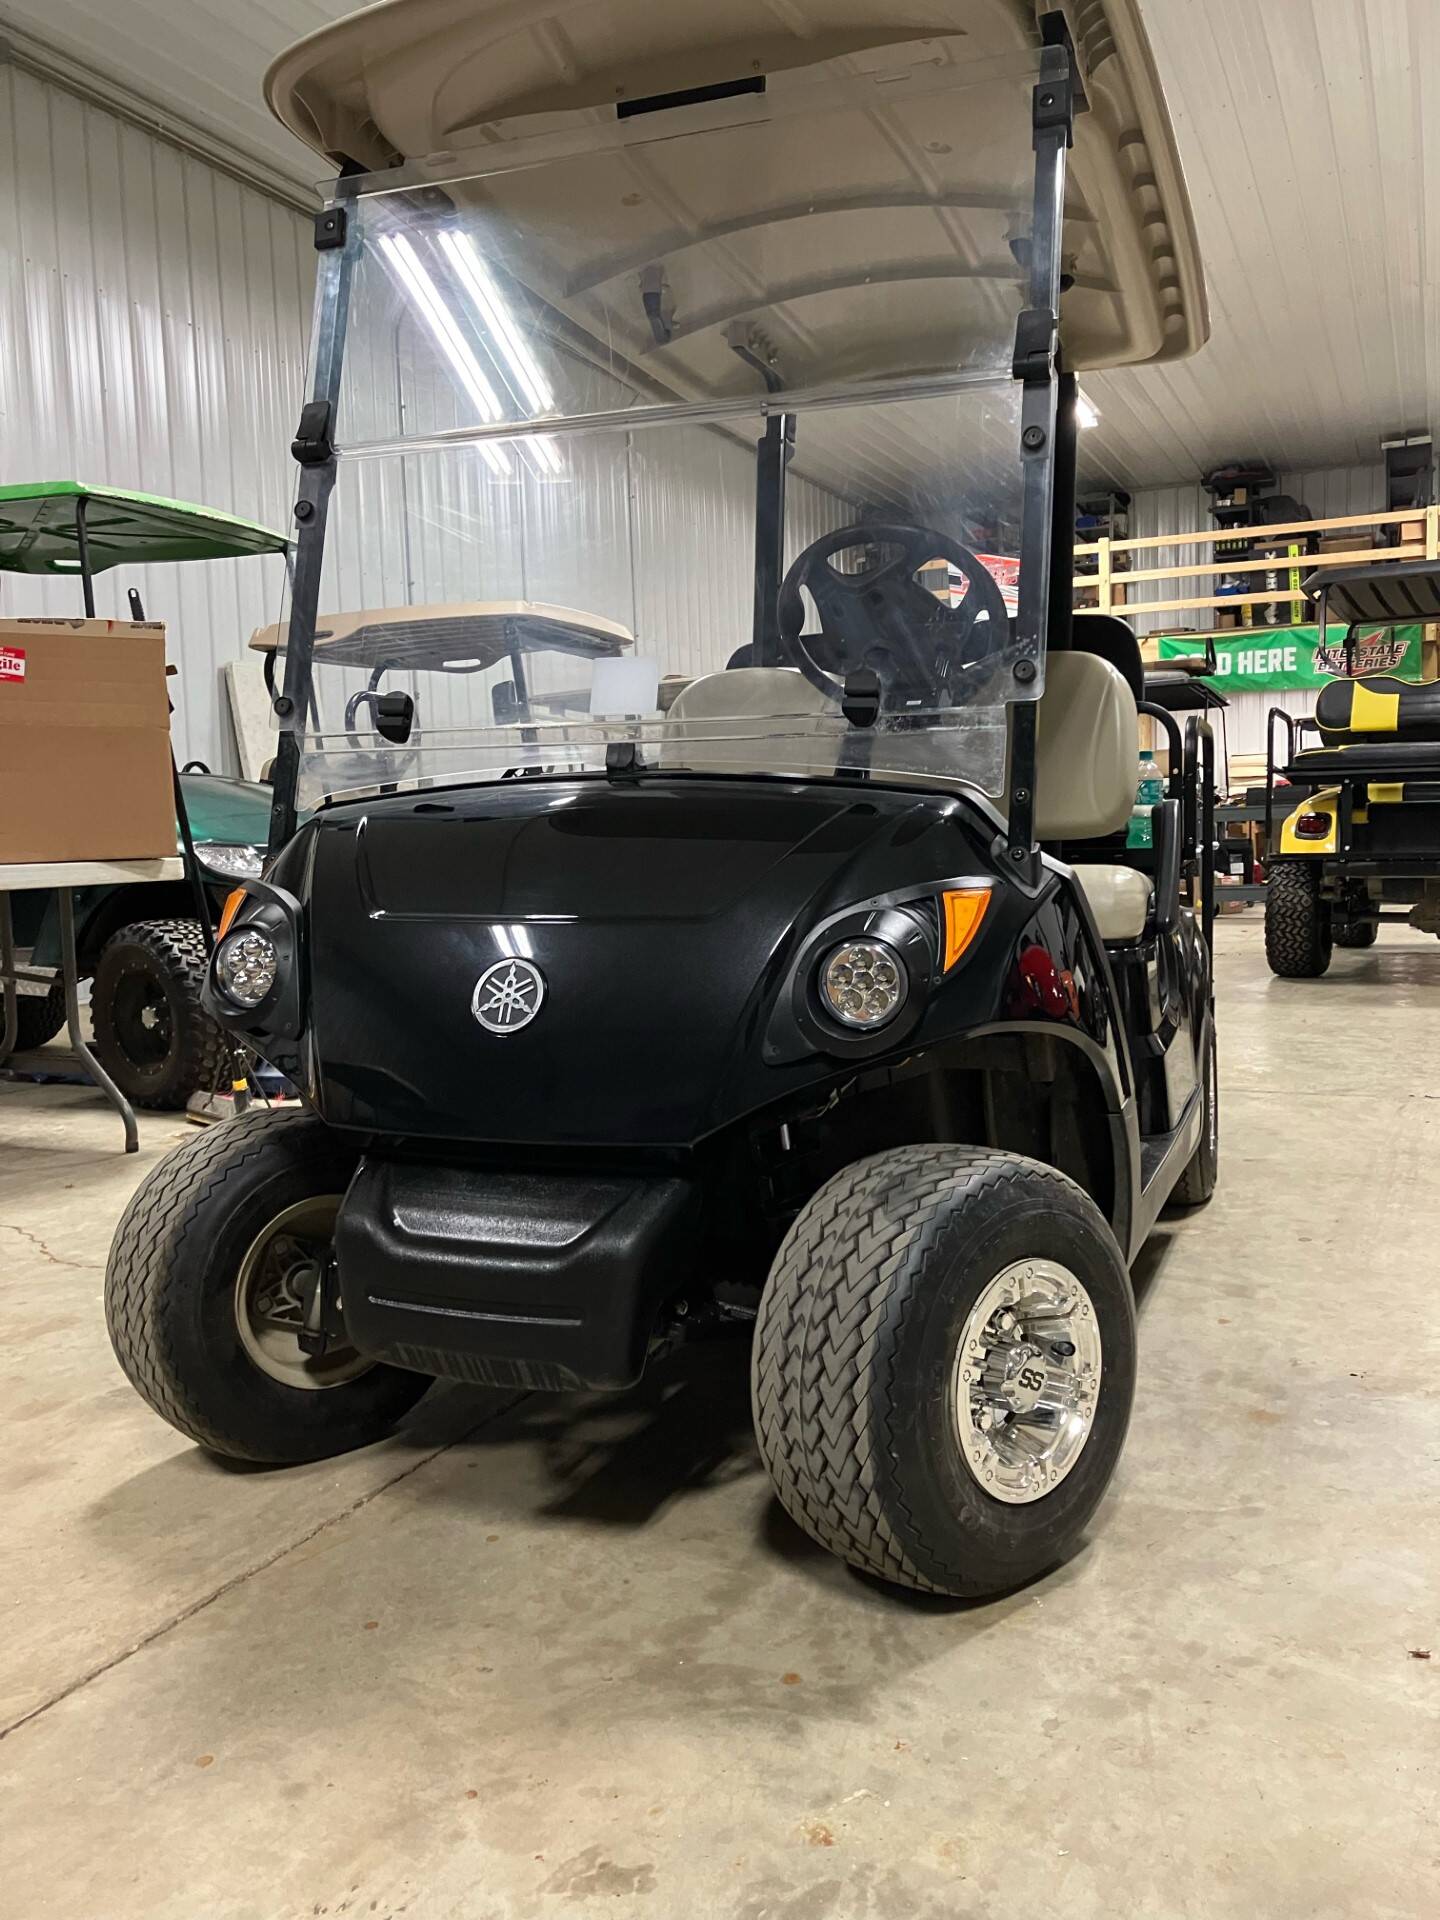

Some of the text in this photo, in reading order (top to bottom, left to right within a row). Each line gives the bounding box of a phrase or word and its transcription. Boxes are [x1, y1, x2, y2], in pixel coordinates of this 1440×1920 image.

[1237, 647, 1297, 674] HERE
[1315, 643, 1404, 659] ITESTATE
[1318, 656, 1397, 671] BTERIES
[1019, 1368, 1044, 1391] SS
